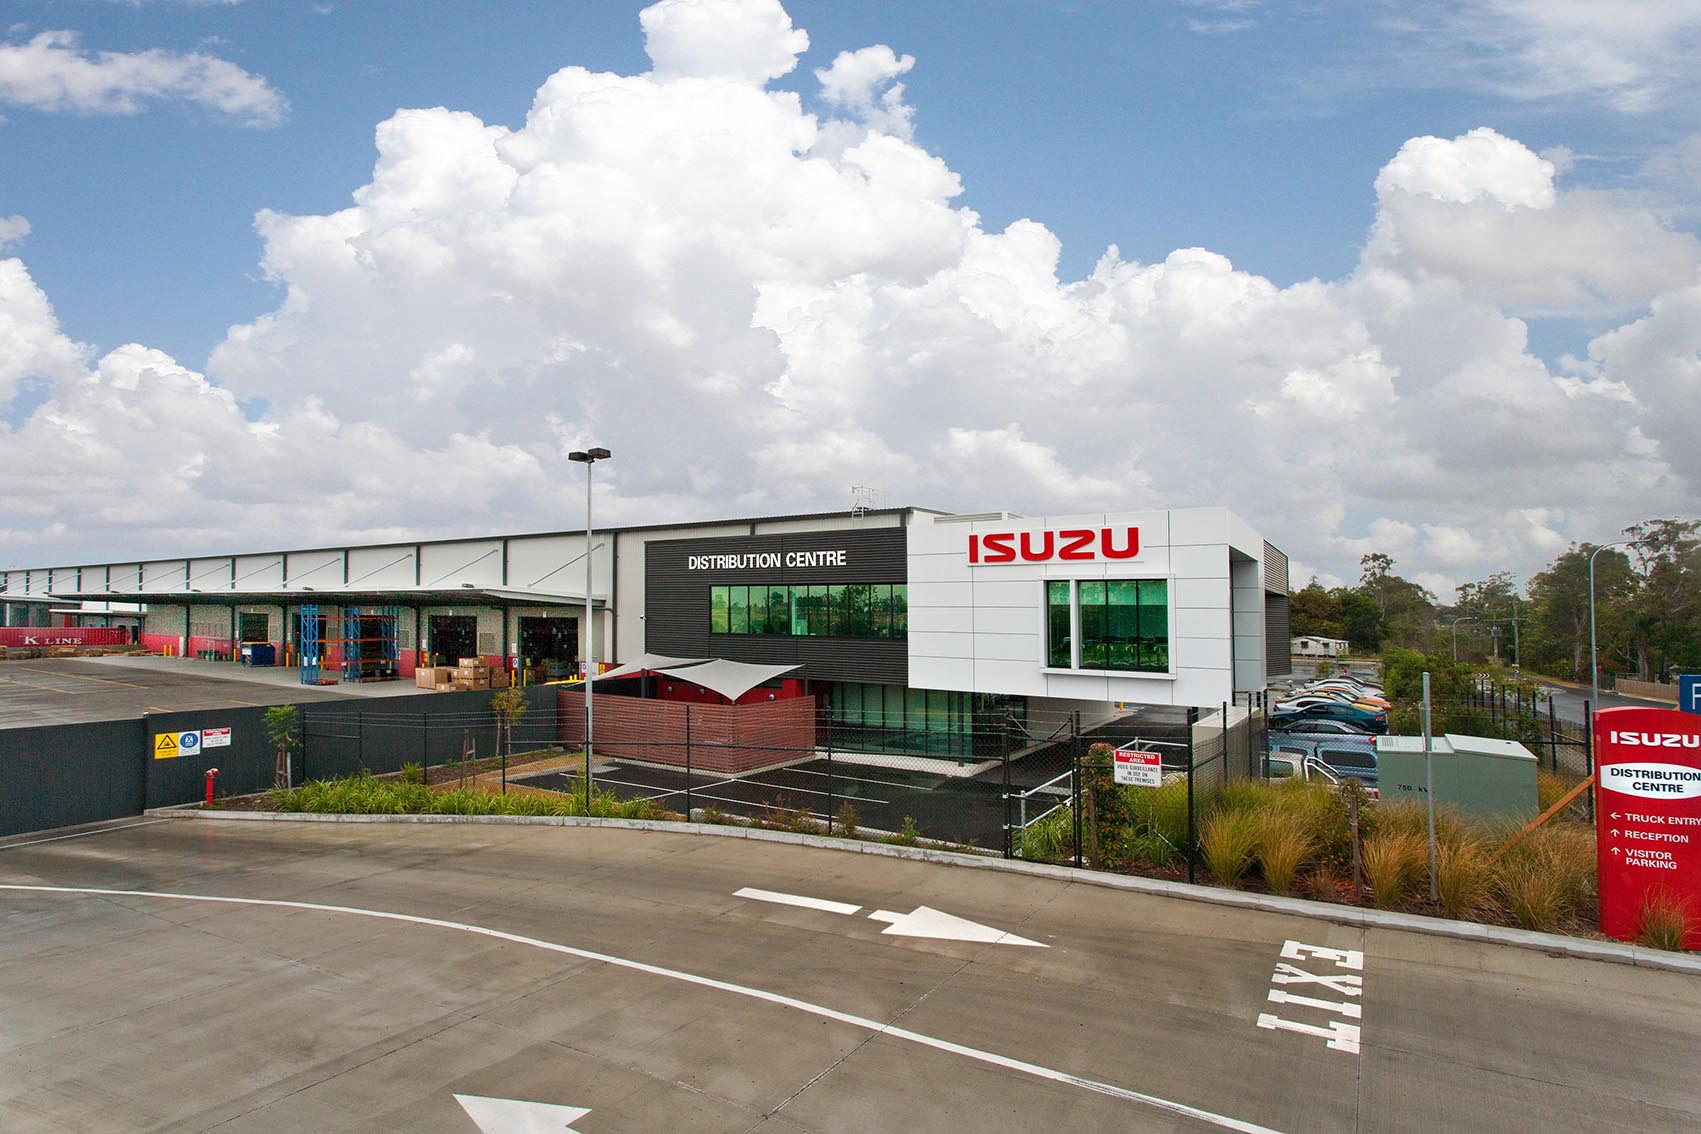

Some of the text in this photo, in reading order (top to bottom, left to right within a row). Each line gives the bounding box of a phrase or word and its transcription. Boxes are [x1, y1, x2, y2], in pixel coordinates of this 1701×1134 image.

[968, 527, 1140, 564] ISUZU
[688, 550, 847, 570] DISTRIBUTION CENTRE
[24, 636, 82, 645] K LINE
[1610, 731, 1700, 748] ISUZU
[1610, 768, 1701, 781] DISTRIBUTION
[1632, 781, 1684, 793] CENTRE
[1625, 812, 1701, 826] TRUCK ENTRY
[1624, 830, 1689, 843] RECEPTION
[1625, 848, 1672, 860] VISITOR
[1625, 857, 1677, 870] PARKING
[1256, 939, 1364, 1055] EXIT
